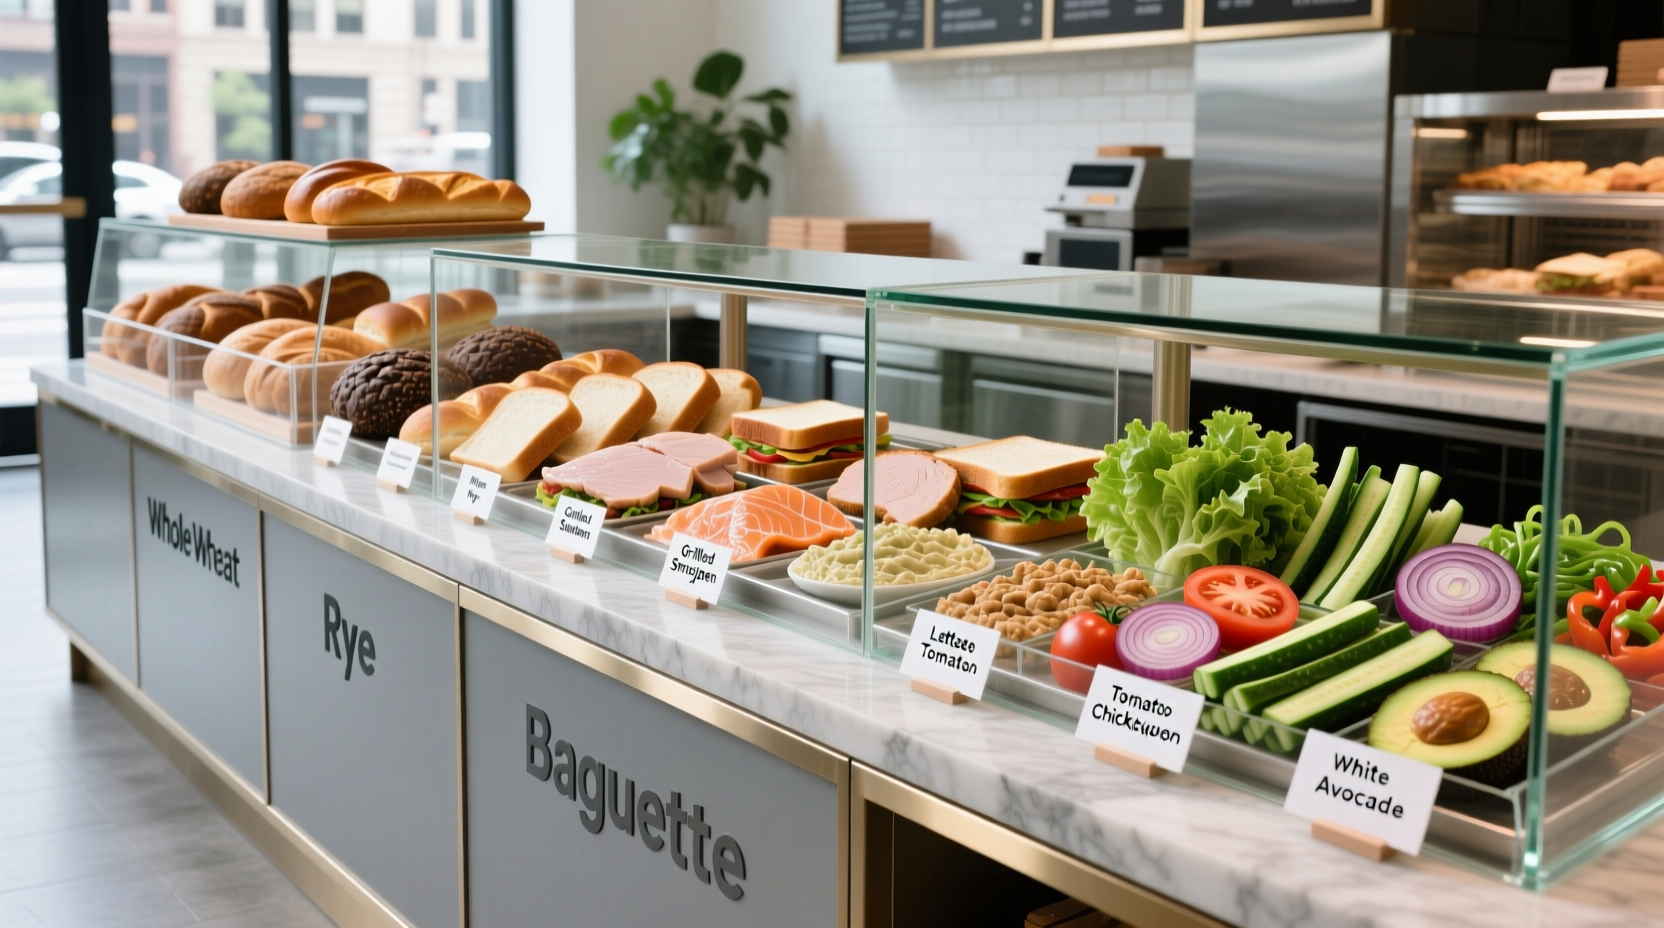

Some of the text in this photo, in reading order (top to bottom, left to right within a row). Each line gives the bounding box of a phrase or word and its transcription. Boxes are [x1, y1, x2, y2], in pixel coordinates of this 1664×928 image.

[148, 496, 191, 557] Whole
[324, 592, 376, 681] Rye
[1315, 776, 1404, 819] Avocade
[1334, 752, 1390, 785] White
[526, 702, 747, 901] Baguette
